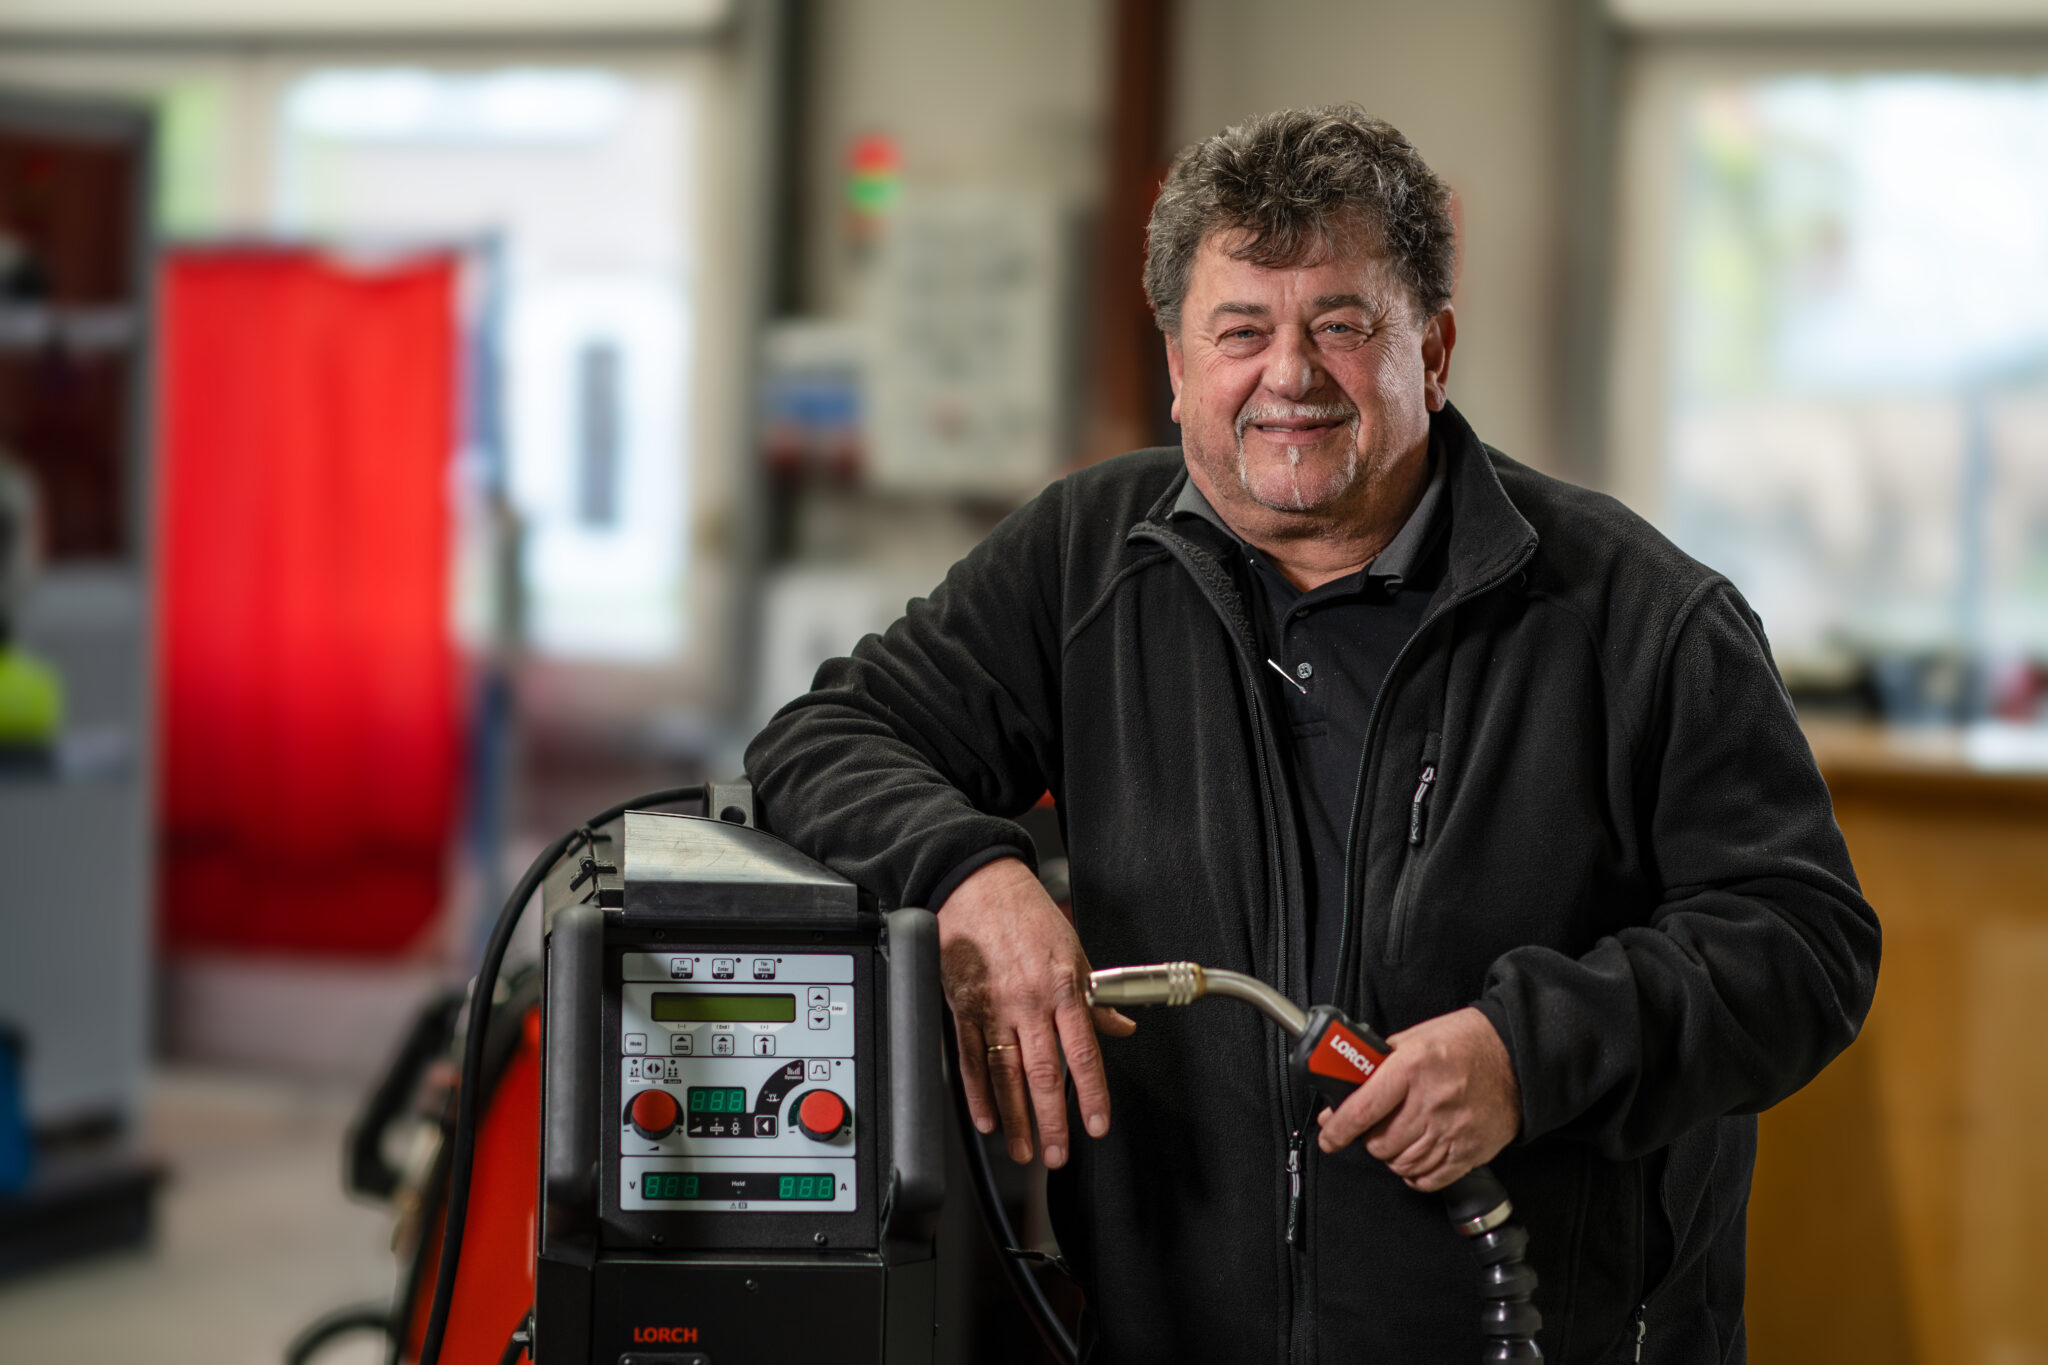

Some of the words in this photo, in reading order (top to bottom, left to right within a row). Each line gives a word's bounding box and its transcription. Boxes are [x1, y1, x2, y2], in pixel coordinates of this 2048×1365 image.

[1330, 1034, 1375, 1076] LORCH
[629, 1181, 636, 1189] V
[840, 1182, 847, 1191] A
[633, 1326, 698, 1343] LORCH
